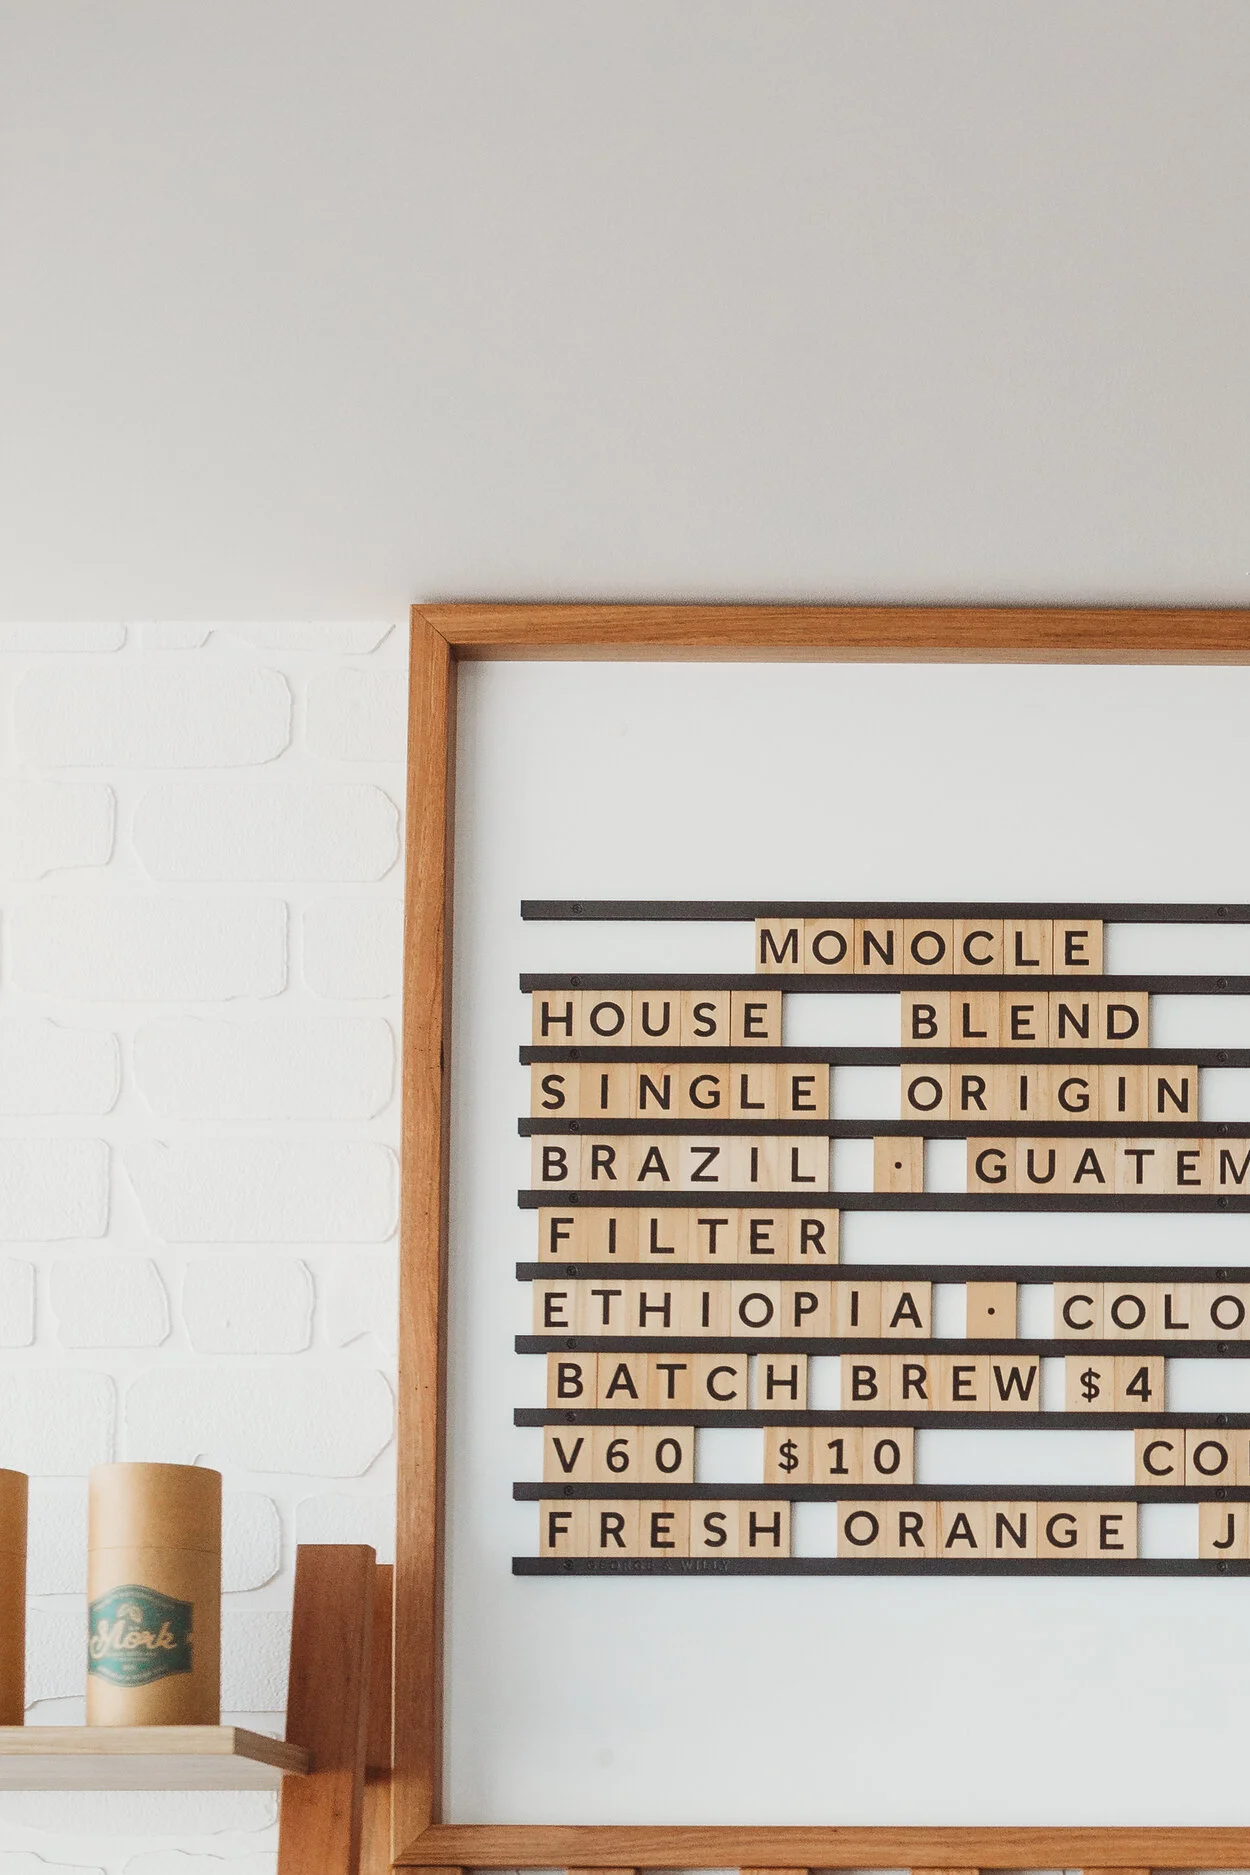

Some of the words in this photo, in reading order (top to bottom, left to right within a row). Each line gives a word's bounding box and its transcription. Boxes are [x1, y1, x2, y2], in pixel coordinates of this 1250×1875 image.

[760, 928, 1090, 967] MONOCLE
[541, 1001, 769, 1039] HOUSE
[912, 1002, 1139, 1041] BLEND
[541, 1073, 817, 1111] SINGLE
[907, 1075, 1189, 1113] ORIGIN
[542, 1144, 816, 1183] BRAZIL
[550, 1217, 826, 1255] FILTER
[544, 1289, 923, 1328] ETHIOPIA
[557, 1362, 798, 1402] BATCH
[852, 1363, 1037, 1401] BREW
[1080, 1366, 1152, 1403] $4
[552, 1437, 682, 1474] V60
[778, 1438, 901, 1475] $10
[548, 1511, 781, 1549] FRESH
[844, 1510, 1124, 1550] ORANGE
[681, 1559, 730, 1571] WILLY
